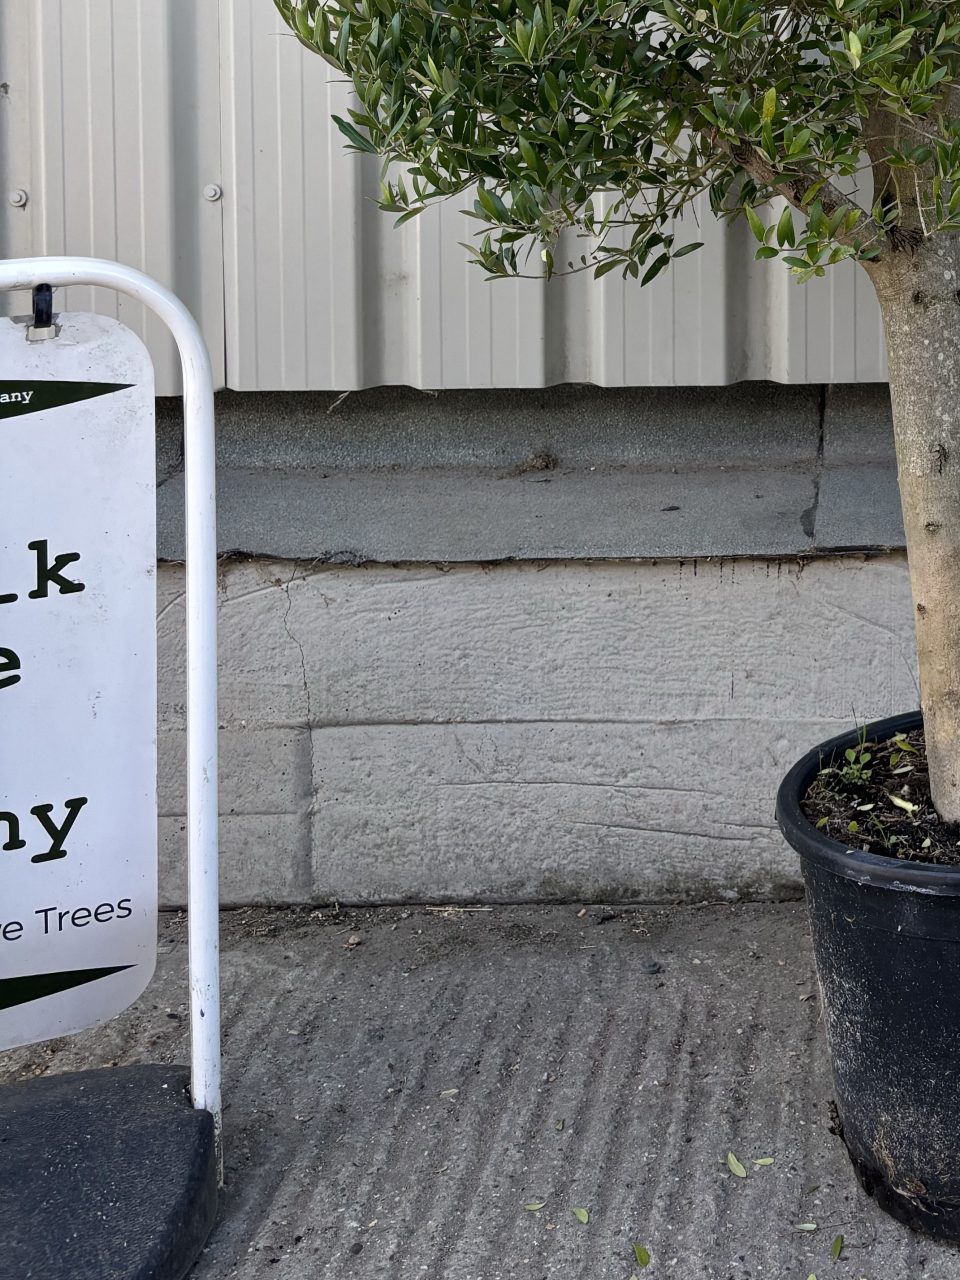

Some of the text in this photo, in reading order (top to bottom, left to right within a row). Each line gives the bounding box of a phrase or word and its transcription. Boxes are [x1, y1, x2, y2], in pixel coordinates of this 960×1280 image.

[0, 390, 34, 404] any
[0, 539, 86, 605] k
[0, 898, 133, 942] e Trees
